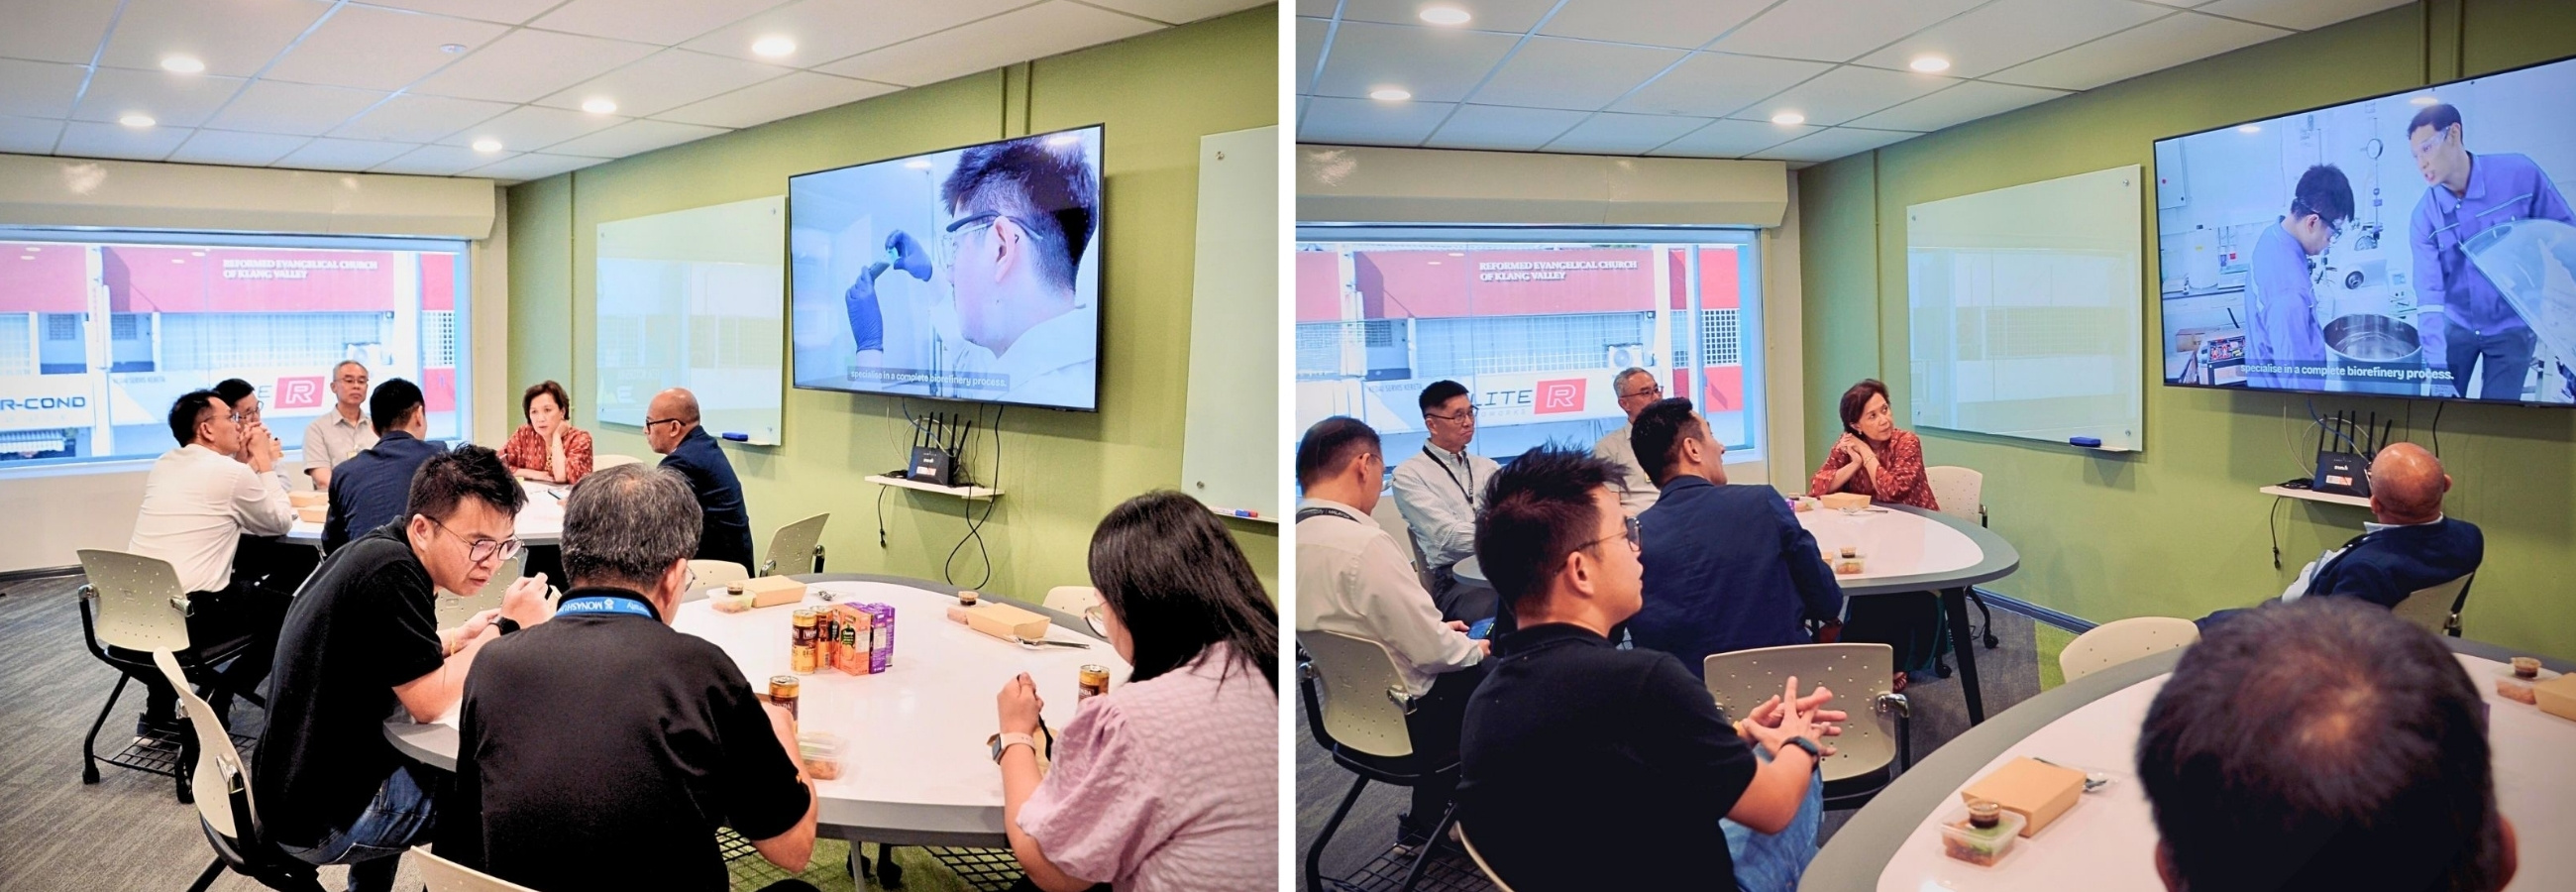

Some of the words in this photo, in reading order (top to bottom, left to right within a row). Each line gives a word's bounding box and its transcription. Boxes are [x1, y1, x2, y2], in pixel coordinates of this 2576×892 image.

[223, 259, 275, 269] REFORMED
[275, 260, 339, 270] EVANGELICAL
[339, 260, 378, 270] CHURCH
[1479, 262, 1533, 271] REFORMED
[1533, 261, 1598, 270] EVANGELICAL
[1598, 260, 1638, 269] CHURCH
[223, 270, 237, 279] OF
[237, 270, 272, 279] KLANG
[273, 270, 308, 279] VALLEY
[1480, 273, 1494, 281] OF
[1495, 272, 1530, 280] KLANG
[1531, 271, 1566, 279] VALLEY
[2240, 363, 2283, 375] specialise
[2284, 364, 2293, 374] in
[2302, 366, 2346, 377] complete
[2347, 366, 2405, 380] biorefinery
[2407, 370, 2454, 381] process.
[850, 370, 883, 379] specialise
[896, 372, 929, 384] complete
[929, 373, 971, 386] biorefinery
[972, 378, 1008, 388] process.
[285, 380, 315, 404] R
[1547, 384, 1576, 408] R
[567, 601, 603, 612] MONASH
